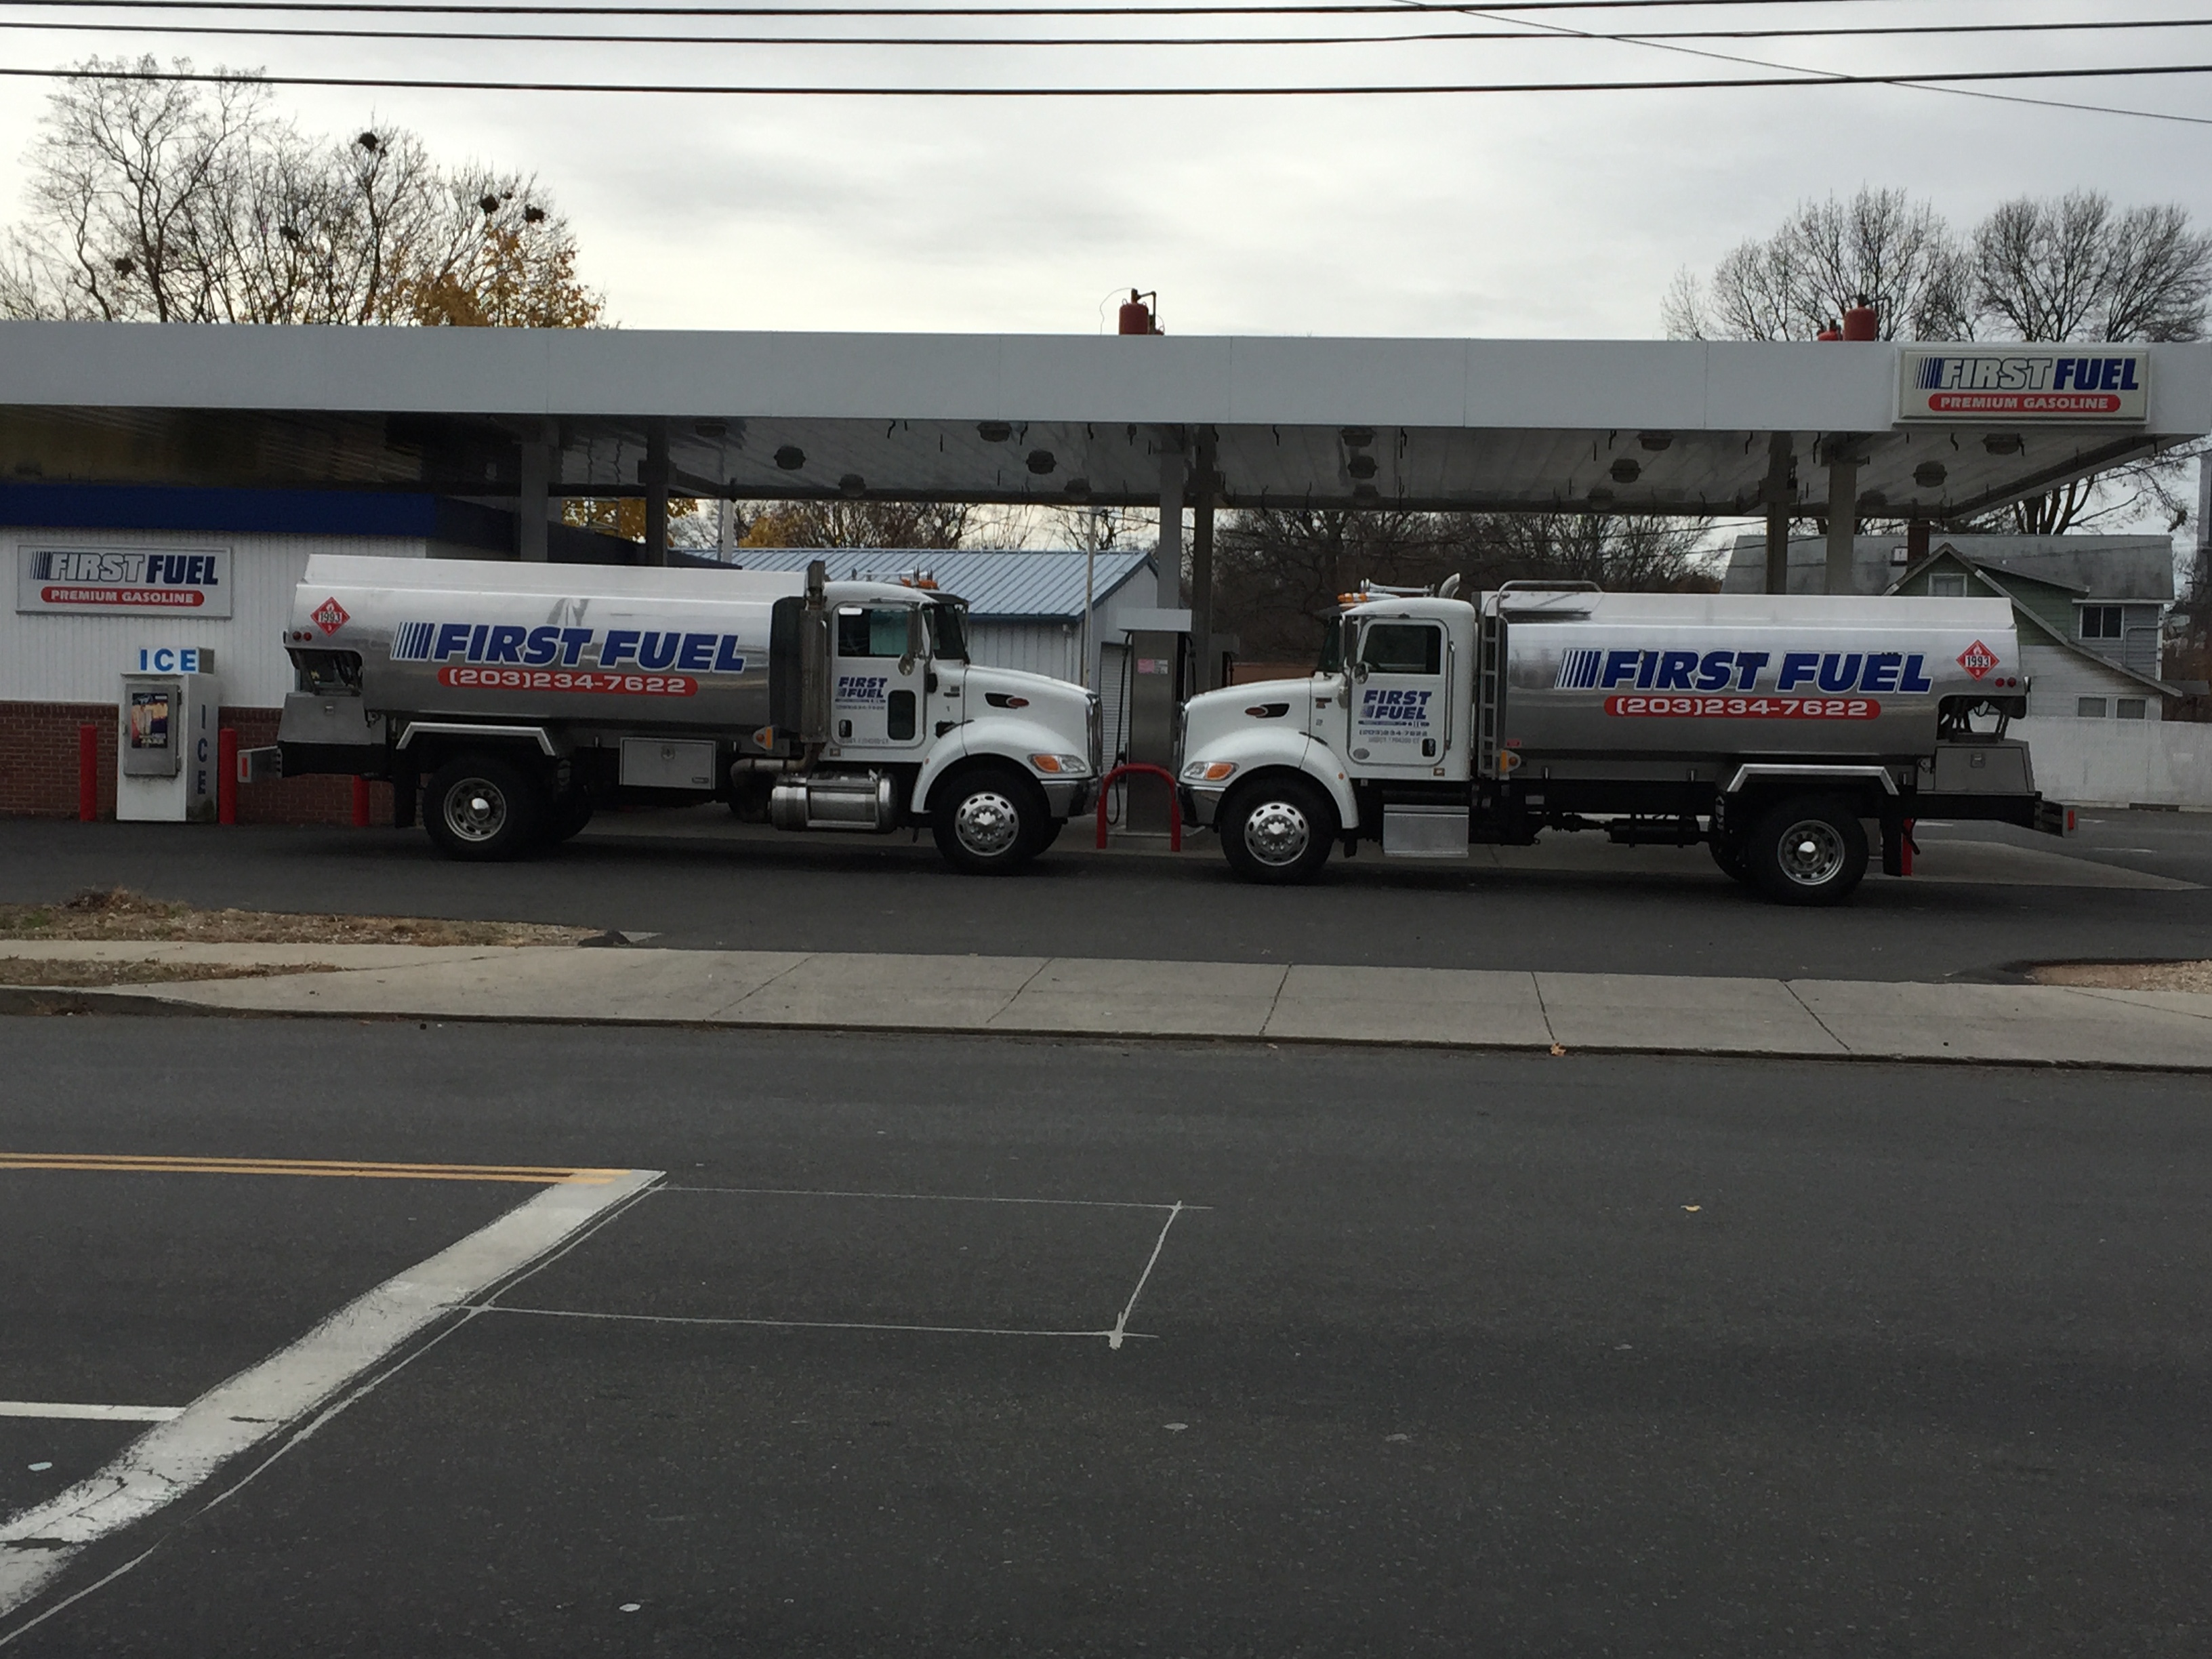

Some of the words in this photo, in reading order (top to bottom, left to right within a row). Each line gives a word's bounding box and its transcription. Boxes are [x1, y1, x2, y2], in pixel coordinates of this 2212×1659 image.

[1940, 357, 2053, 390] FIRST
[2053, 358, 2139, 390] FUEL
[1940, 397, 2018, 409] PREMIUM
[2024, 398, 2108, 409] GASOLINE
[49, 552, 145, 583] FIRST
[146, 555, 218, 585] FUEL
[52, 590, 117, 602] PREMIUM
[121, 591, 194, 603] GASOLINE
[320, 611, 341, 623] 1993
[432, 623, 594, 667] FIRST
[598, 629, 745, 673] FUEL
[140, 649, 197, 671] ICE
[1967, 656, 1989, 667] 1993
[1599, 649, 1771, 692] FIRST
[1775, 651, 1933, 694] FUEL
[449, 668, 686, 693] (203)234-7622
[838, 676, 888, 688] FIRST
[847, 689, 884, 698] FUEL
[1364, 690, 1432, 705] FIRST
[1374, 705, 1427, 719] FUEL
[1615, 697, 1868, 716] (203)234-7622
[197, 705, 207, 794] ICE
